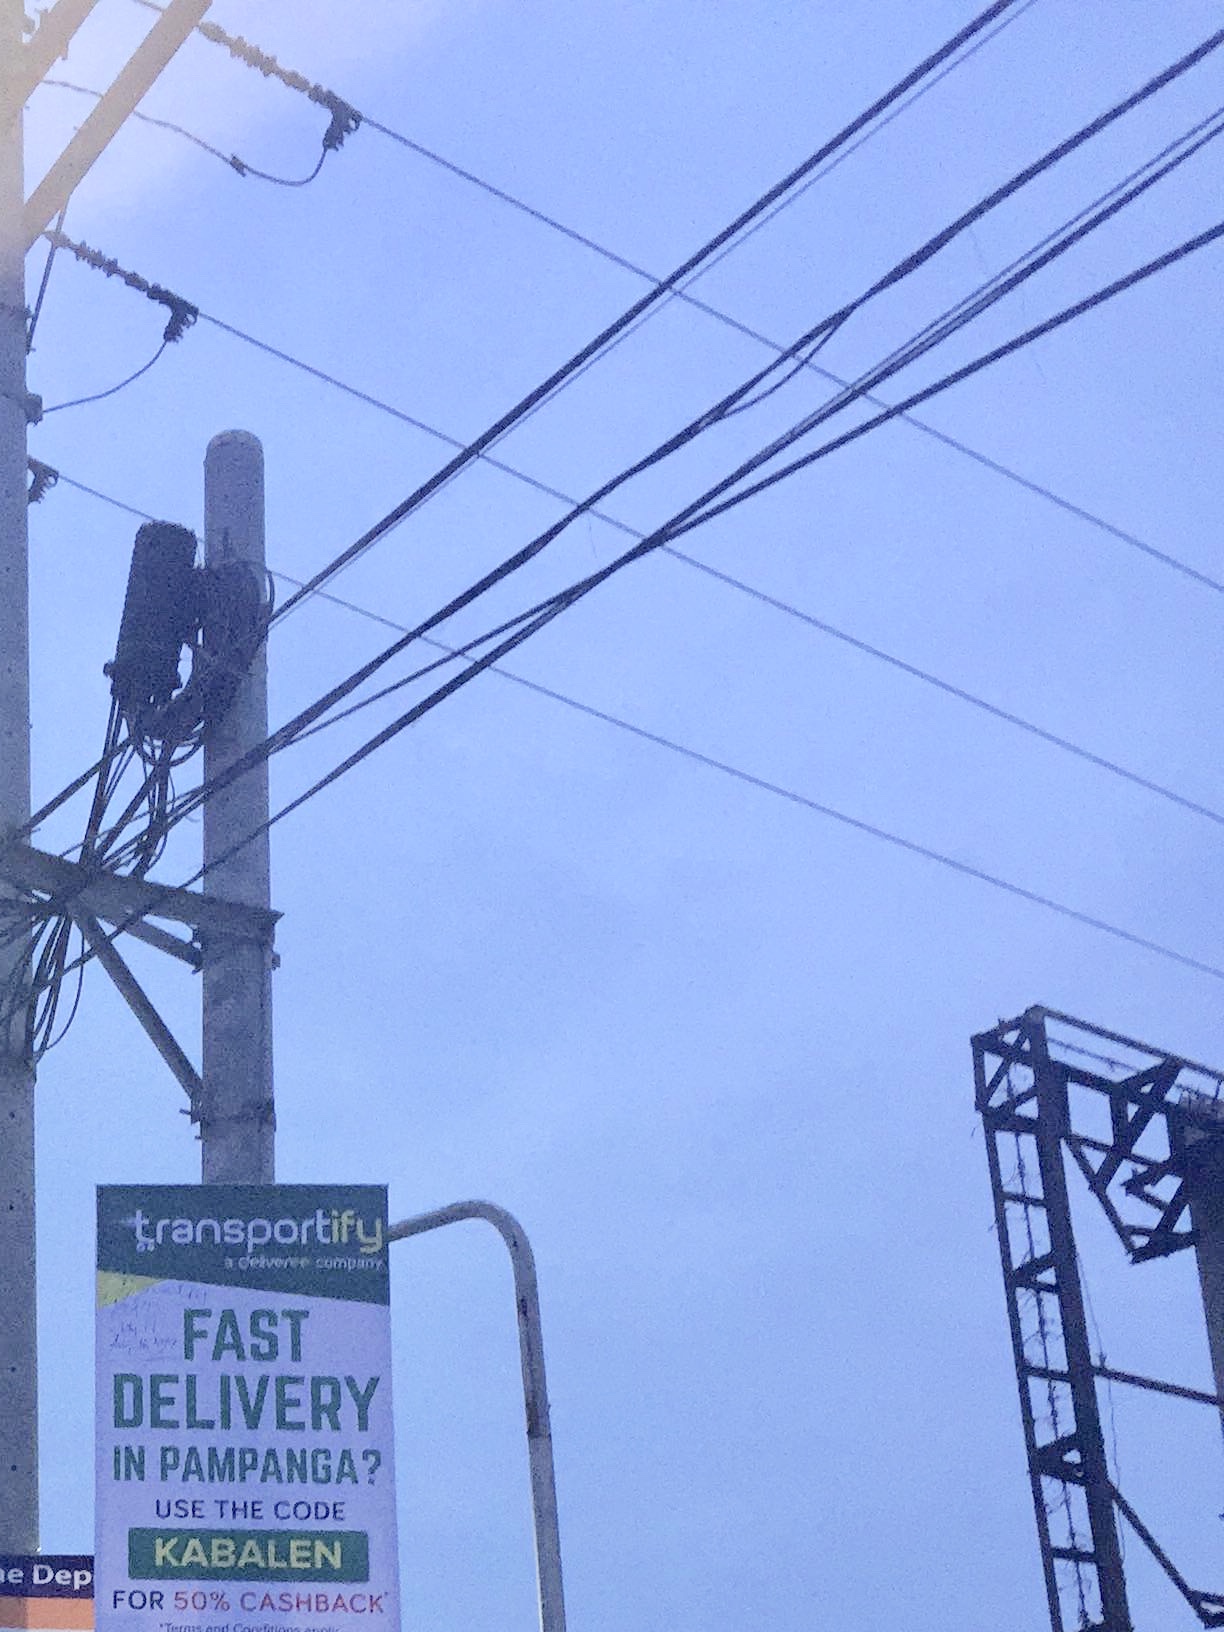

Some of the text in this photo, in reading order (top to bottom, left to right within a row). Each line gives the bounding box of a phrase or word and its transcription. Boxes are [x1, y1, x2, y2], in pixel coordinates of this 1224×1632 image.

[136, 1209, 382, 1253] transportify
[182, 1308, 310, 1362] FAST
[112, 1372, 381, 1432] DELIVERY
[113, 1445, 382, 1486] IN PAMPANGA?
[155, 1499, 345, 1521] USE THE CODE
[152, 1536, 343, 1570] KABALEN
[33, 1564, 93, 1589] Dep
[113, 1590, 165, 1611] FOR
[174, 1591, 232, 1612] 50%
